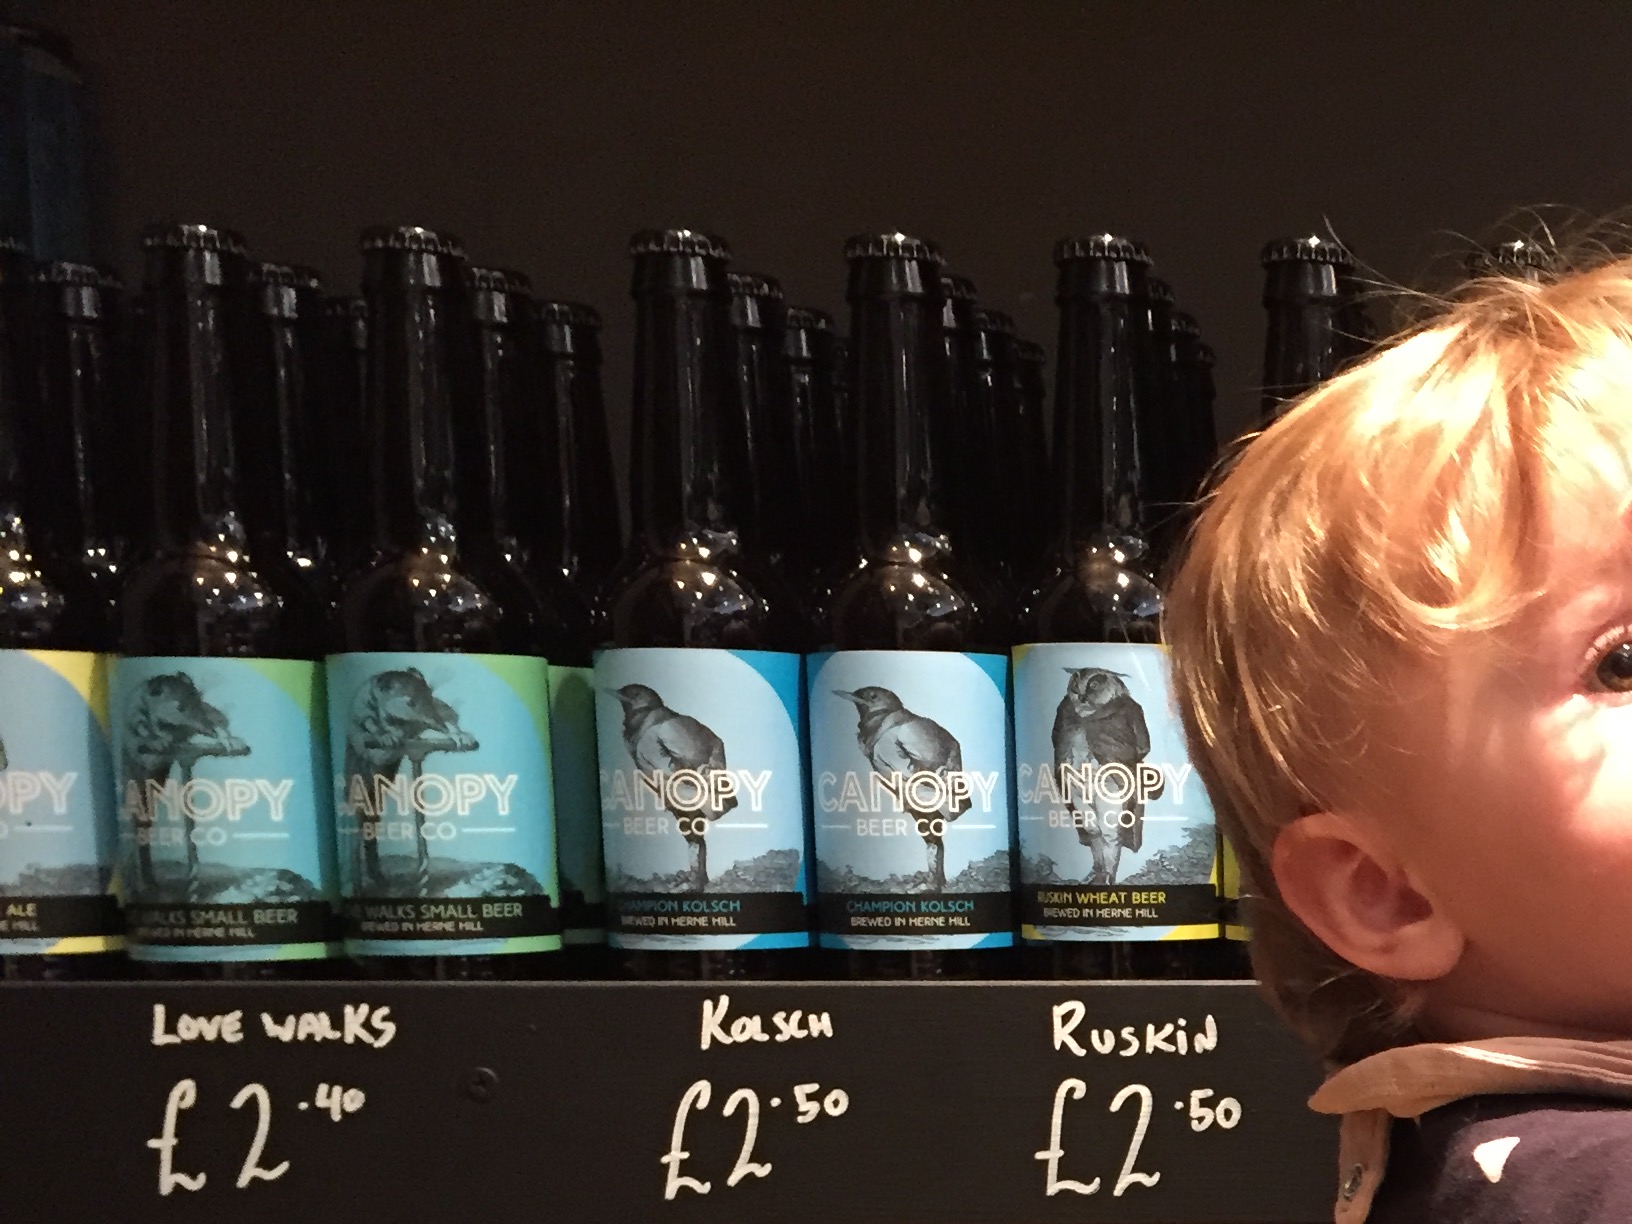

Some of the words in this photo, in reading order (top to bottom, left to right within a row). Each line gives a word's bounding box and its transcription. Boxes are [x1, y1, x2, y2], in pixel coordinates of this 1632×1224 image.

[818, 771, 999, 813] CANOPY
[1017, 763, 1192, 804] CANOPY
[0, 772, 78, 815] PY
[623, 818, 668, 835] BEER
[676, 817, 709, 835] CO
[856, 819, 908, 836] BEER
[915, 819, 947, 836] CO
[1049, 811, 1097, 827] BEER
[1104, 810, 1136, 828] CO
[136, 827, 184, 845] BEER
[190, 827, 227, 846] CO
[363, 822, 414, 840] BEER
[419, 822, 456, 840] CO
[683, 900, 740, 912] KOLSCH
[847, 901, 916, 912] CHAMPION
[921, 900, 974, 912] KOLSCH
[1077, 892, 1127, 904] WHEAT
[1132, 892, 1166, 903] BEER
[190, 909, 248, 924] SMALL
[253, 908, 298, 924] BEER
[364, 904, 415, 919] WALKS
[420, 904, 478, 918] SMALL
[482, 903, 523, 918] BEER
[1083, 908, 1094, 918] IN
[1096, 908, 1132, 918] HERNE
[1136, 908, 1158, 917] HILL
[459, 921, 484, 931] HILL
[658, 916, 668, 927] IN
[671, 916, 708, 927] HERNE
[712, 916, 736, 926] HILL
[851, 917, 891, 927] BREWED
[894, 917, 906, 927] IN
[909, 916, 946, 927] HERNE
[949, 916, 970, 926] HILL
[152, 1004, 245, 1046] LOVE
[261, 1004, 396, 1048] WALKS
[700, 995, 833, 1051] KOLSCH
